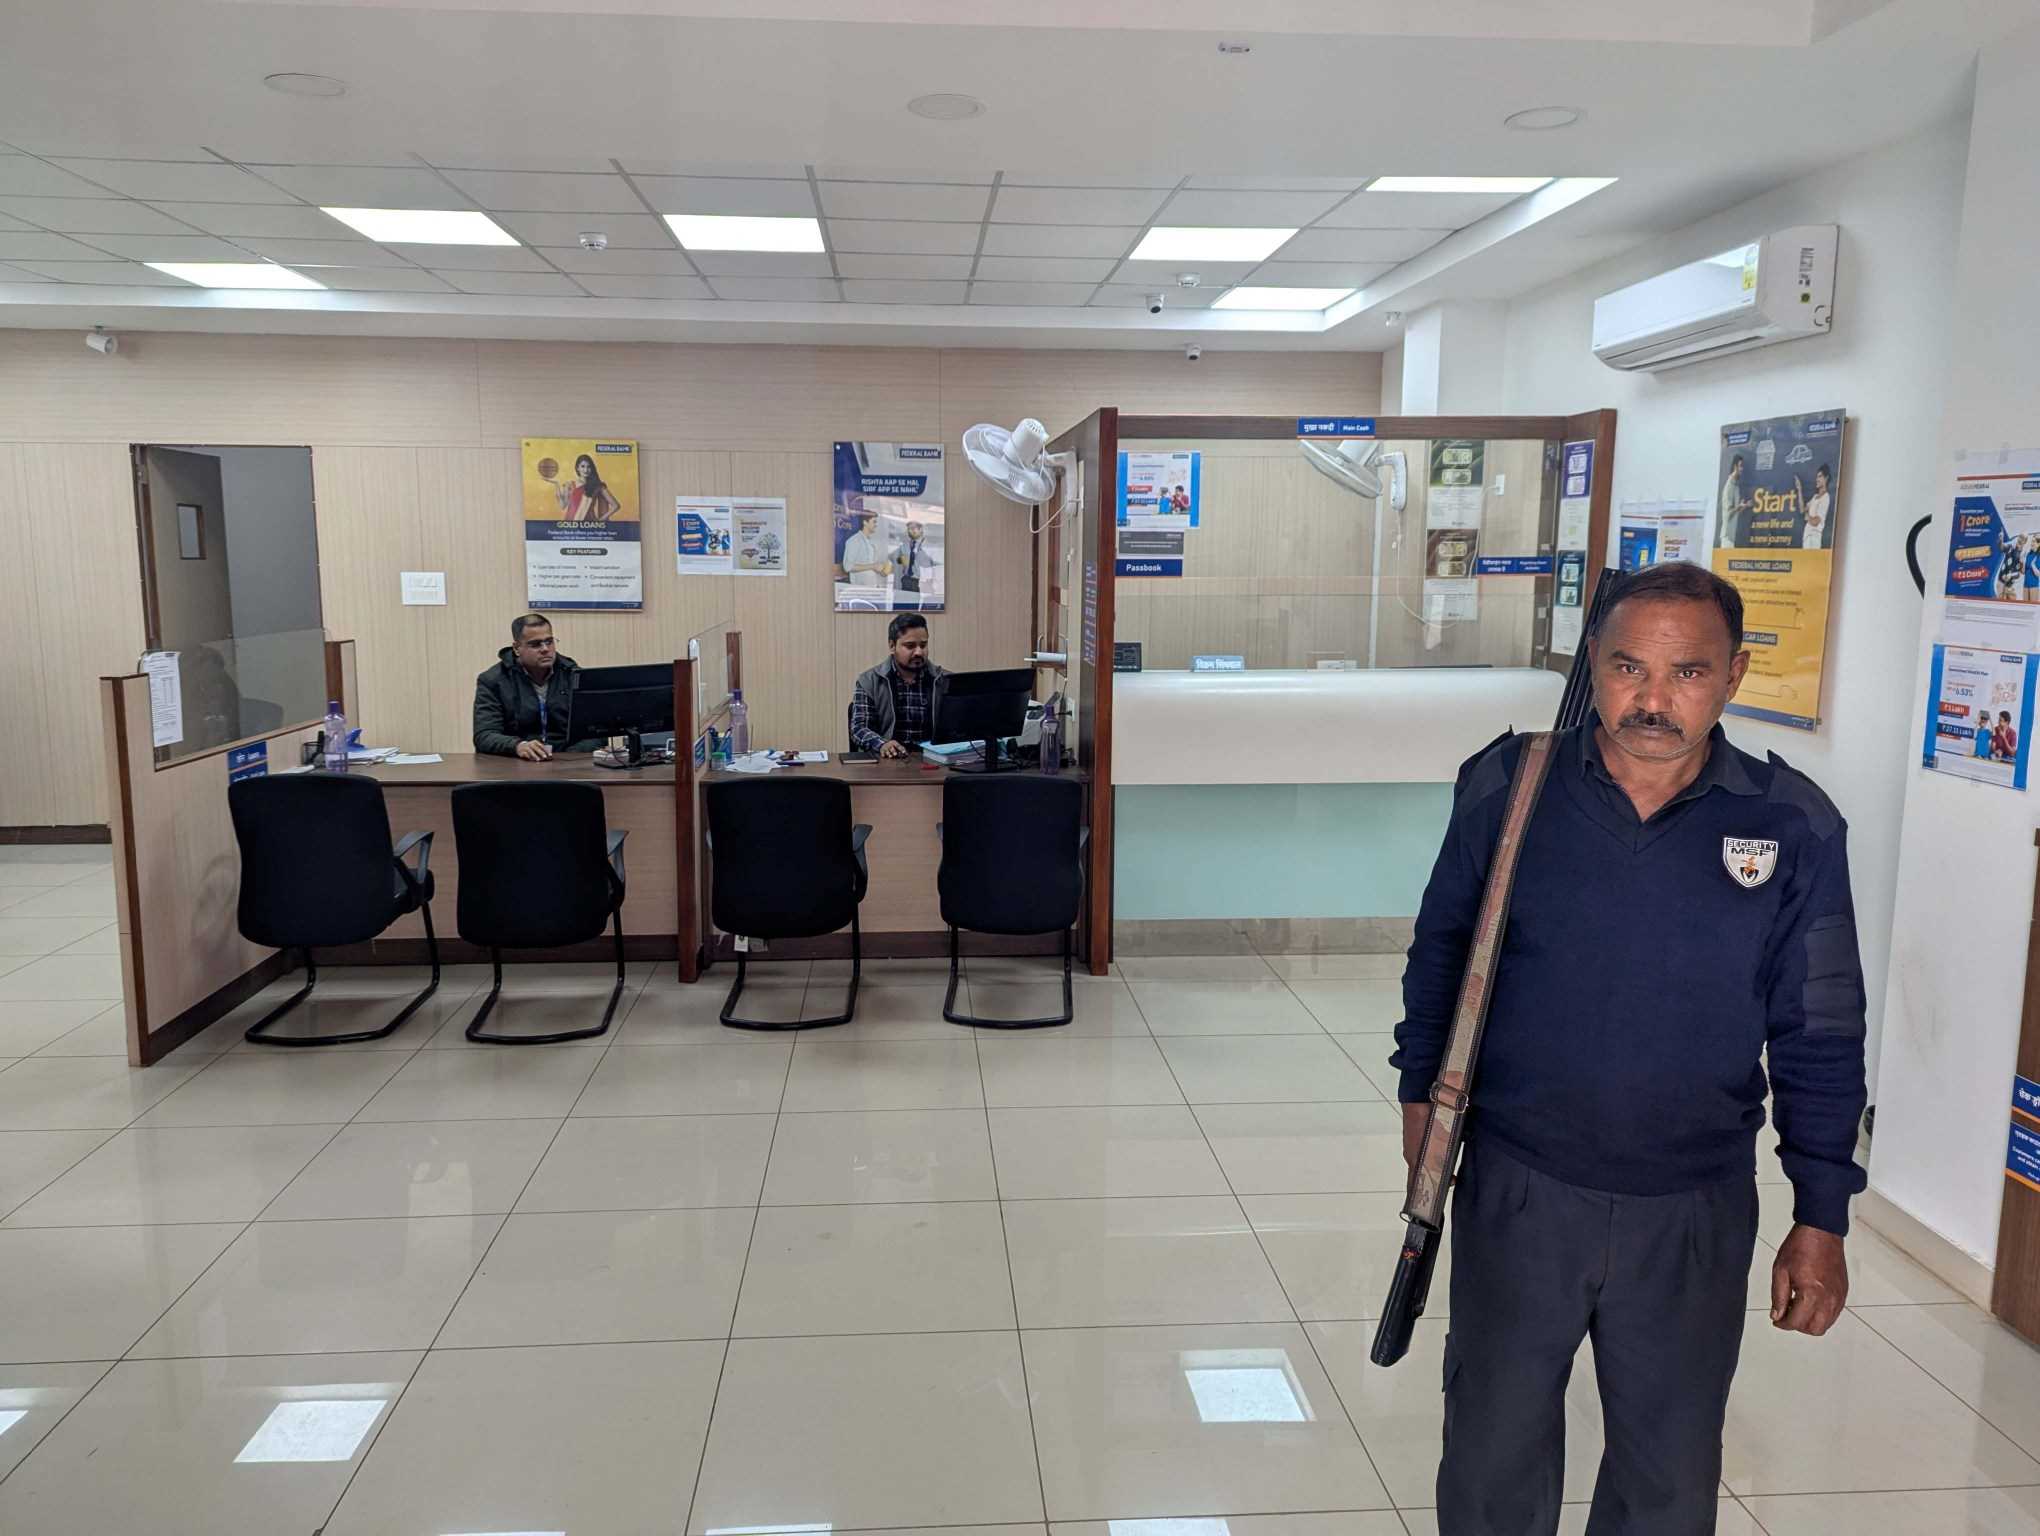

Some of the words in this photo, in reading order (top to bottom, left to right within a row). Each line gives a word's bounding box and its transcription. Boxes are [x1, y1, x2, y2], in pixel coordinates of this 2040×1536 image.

[1753, 487, 1797, 513] Start
[556, 521, 579, 529] GOLD
[580, 521, 606, 529] LOANS
[1781, 518, 1793, 528] and
[1126, 563, 1162, 572] Passbook
[1728, 840, 1775, 849] SECURITY
[1731, 848, 1770, 856] MSF
